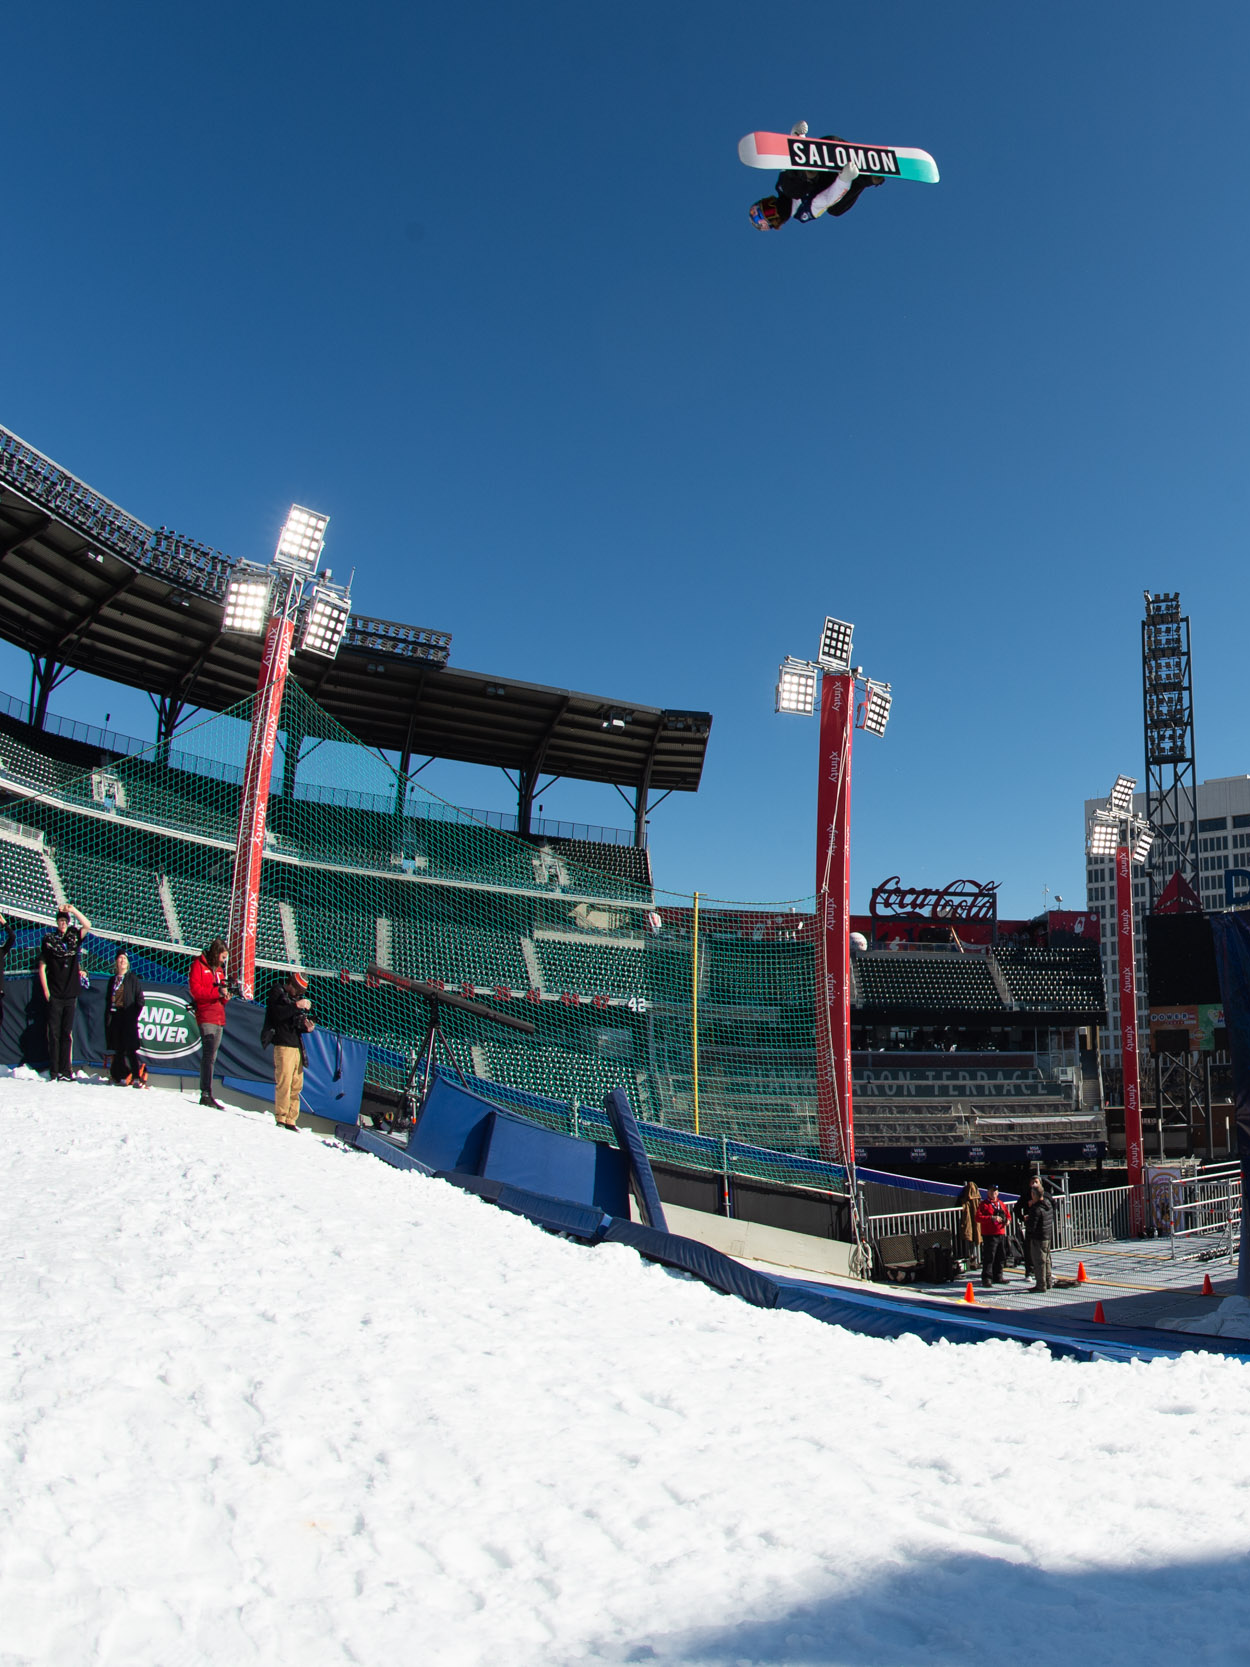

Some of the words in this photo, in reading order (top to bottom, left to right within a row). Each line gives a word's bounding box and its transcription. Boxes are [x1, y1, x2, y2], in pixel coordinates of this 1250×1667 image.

[793, 142, 897, 173] SALOMON
[278, 631, 290, 673] xfinity
[832, 681, 842, 712] xfinity
[263, 714, 277, 757] xfinity
[828, 751, 841, 783] xfinity
[254, 801, 265, 846] xfinity
[1119, 851, 1128, 878] xfinity
[247, 891, 258, 937] xfinity
[1121, 909, 1130, 936] xfinity
[1123, 967, 1133, 994] xfinity
[137, 1006, 174, 1024] AND
[628, 998, 647, 1012] 42
[1151, 1012, 1188, 1022] POWER
[1124, 1025, 1135, 1053] xfinity
[925, 1070, 1048, 1096] TERRACE
[1127, 1083, 1137, 1111] xfinity
[1130, 1142, 1140, 1169] xfinity
